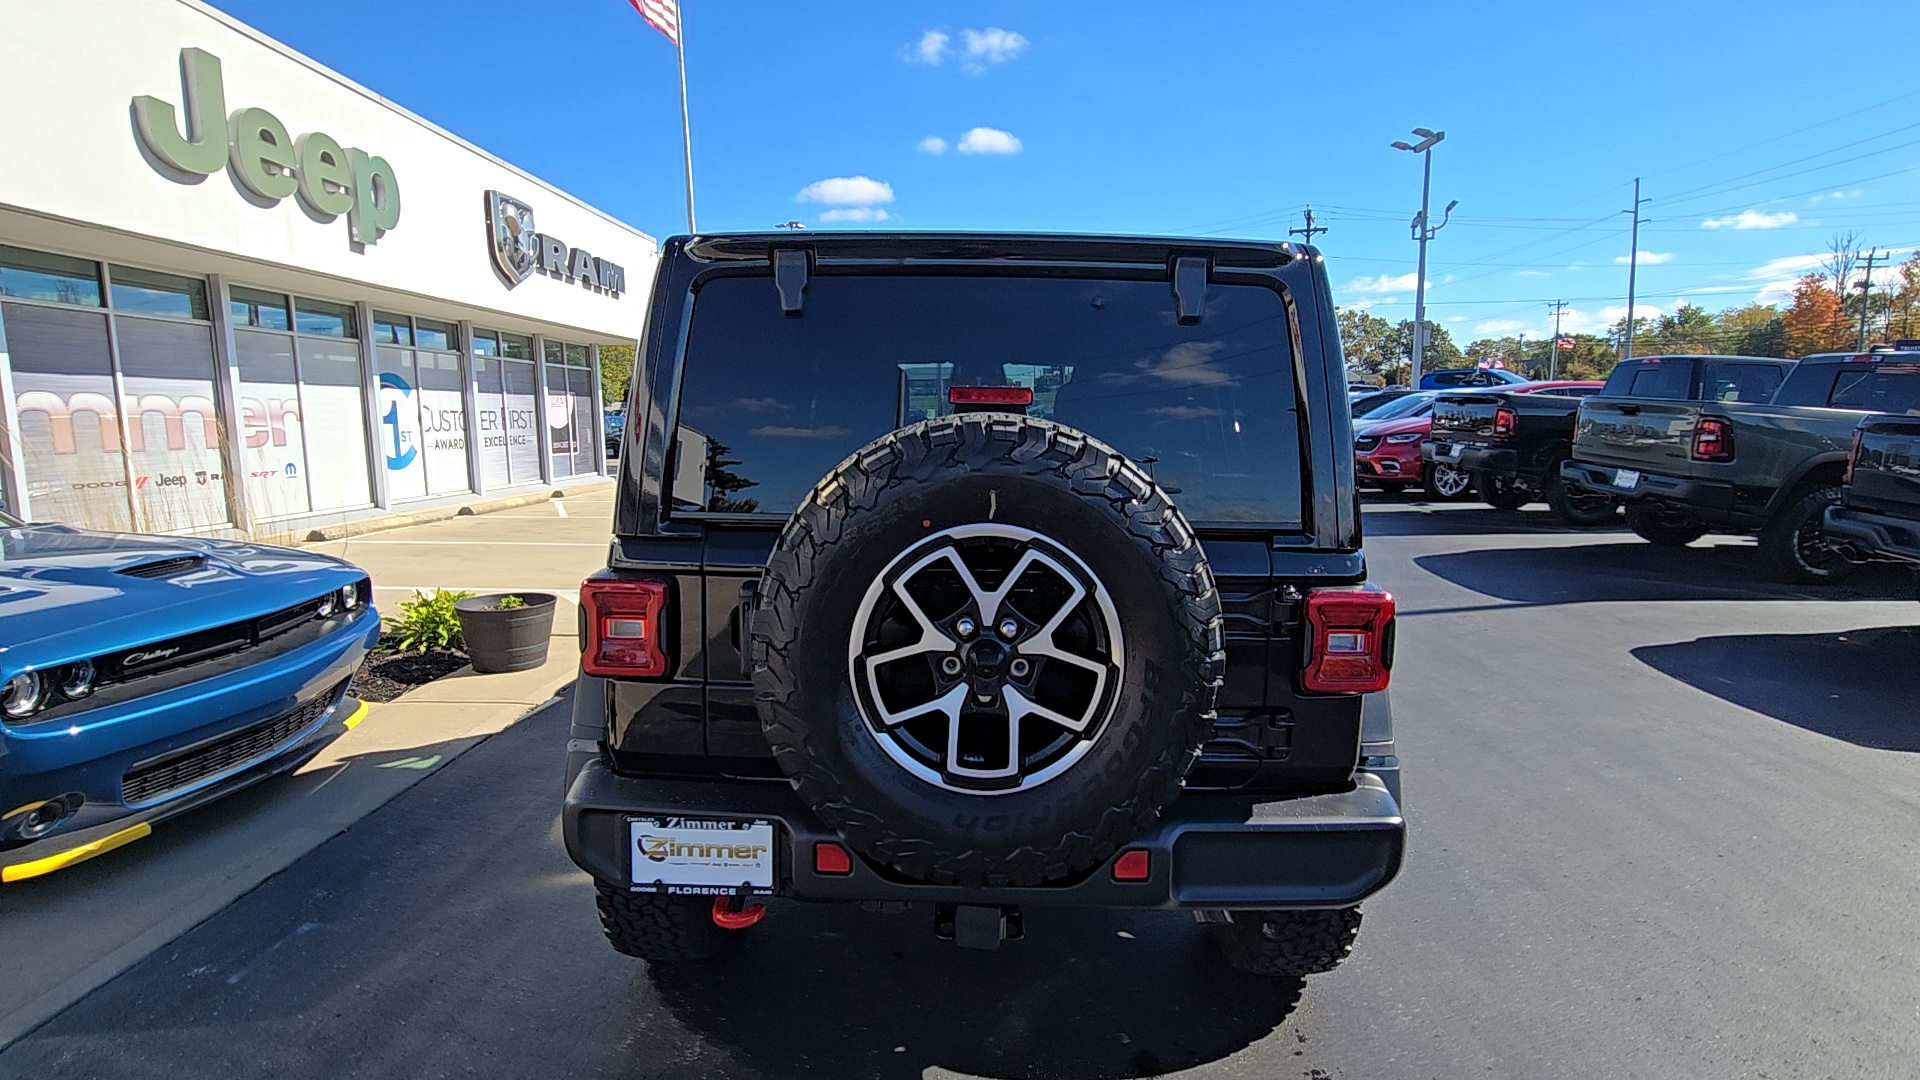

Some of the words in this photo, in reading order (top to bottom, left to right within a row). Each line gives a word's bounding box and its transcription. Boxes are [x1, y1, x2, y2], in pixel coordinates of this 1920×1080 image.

[131, 47, 401, 247] Jeep
[535, 233, 626, 294] RAM
[17, 391, 300, 455] mmer
[434, 438, 465, 451] AWARD
[484, 435, 527, 448] EXCELENCE
[72, 480, 128, 490] DODG
[155, 473, 187, 488] Jeep
[250, 470, 279, 479] SRT
[666, 817, 737, 830] Zimmer
[645, 836, 768, 860] Zimmer
[668, 886, 737, 896] FLORENCE
